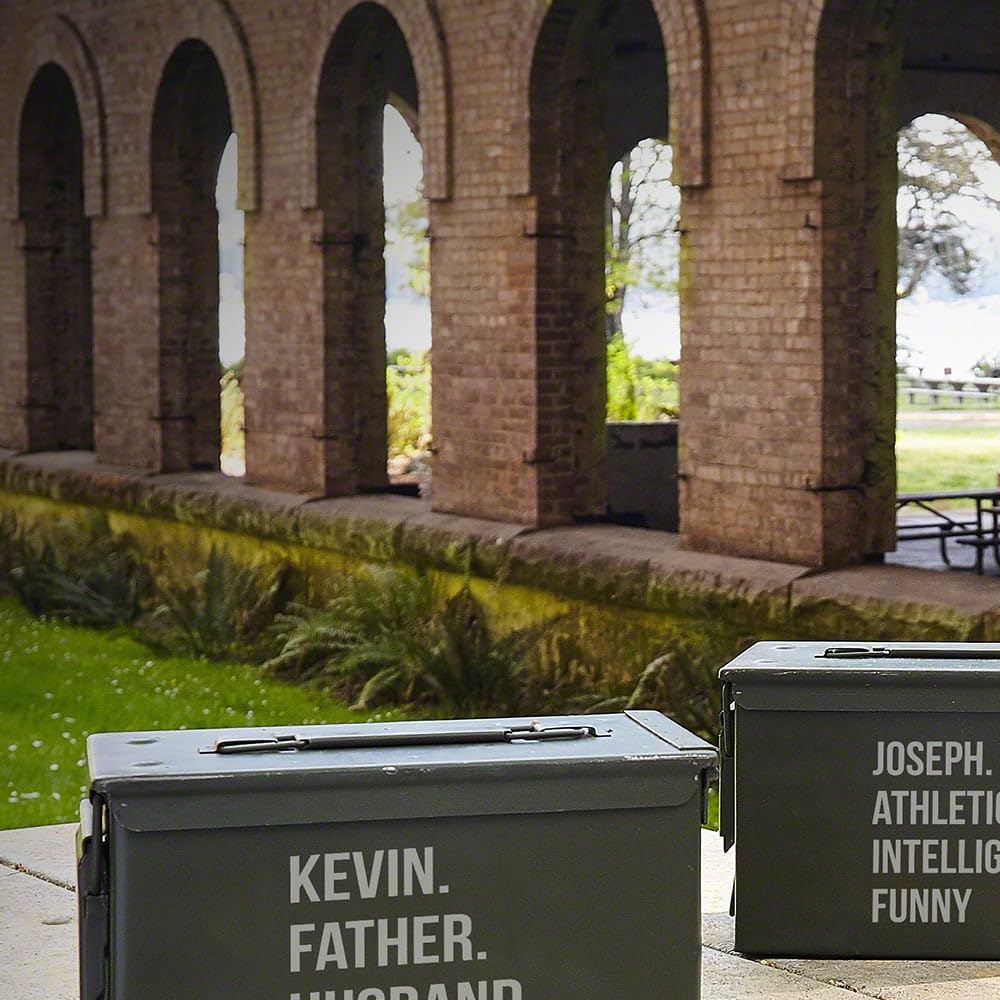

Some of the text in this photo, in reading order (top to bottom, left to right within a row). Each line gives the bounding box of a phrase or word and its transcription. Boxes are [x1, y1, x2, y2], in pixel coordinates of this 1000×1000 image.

[872, 741, 993, 776] JOSEPH.
[289, 846, 449, 904] KEVIN.
[872, 888, 973, 923] FUNNY
[290, 913, 487, 973] FATHER.
